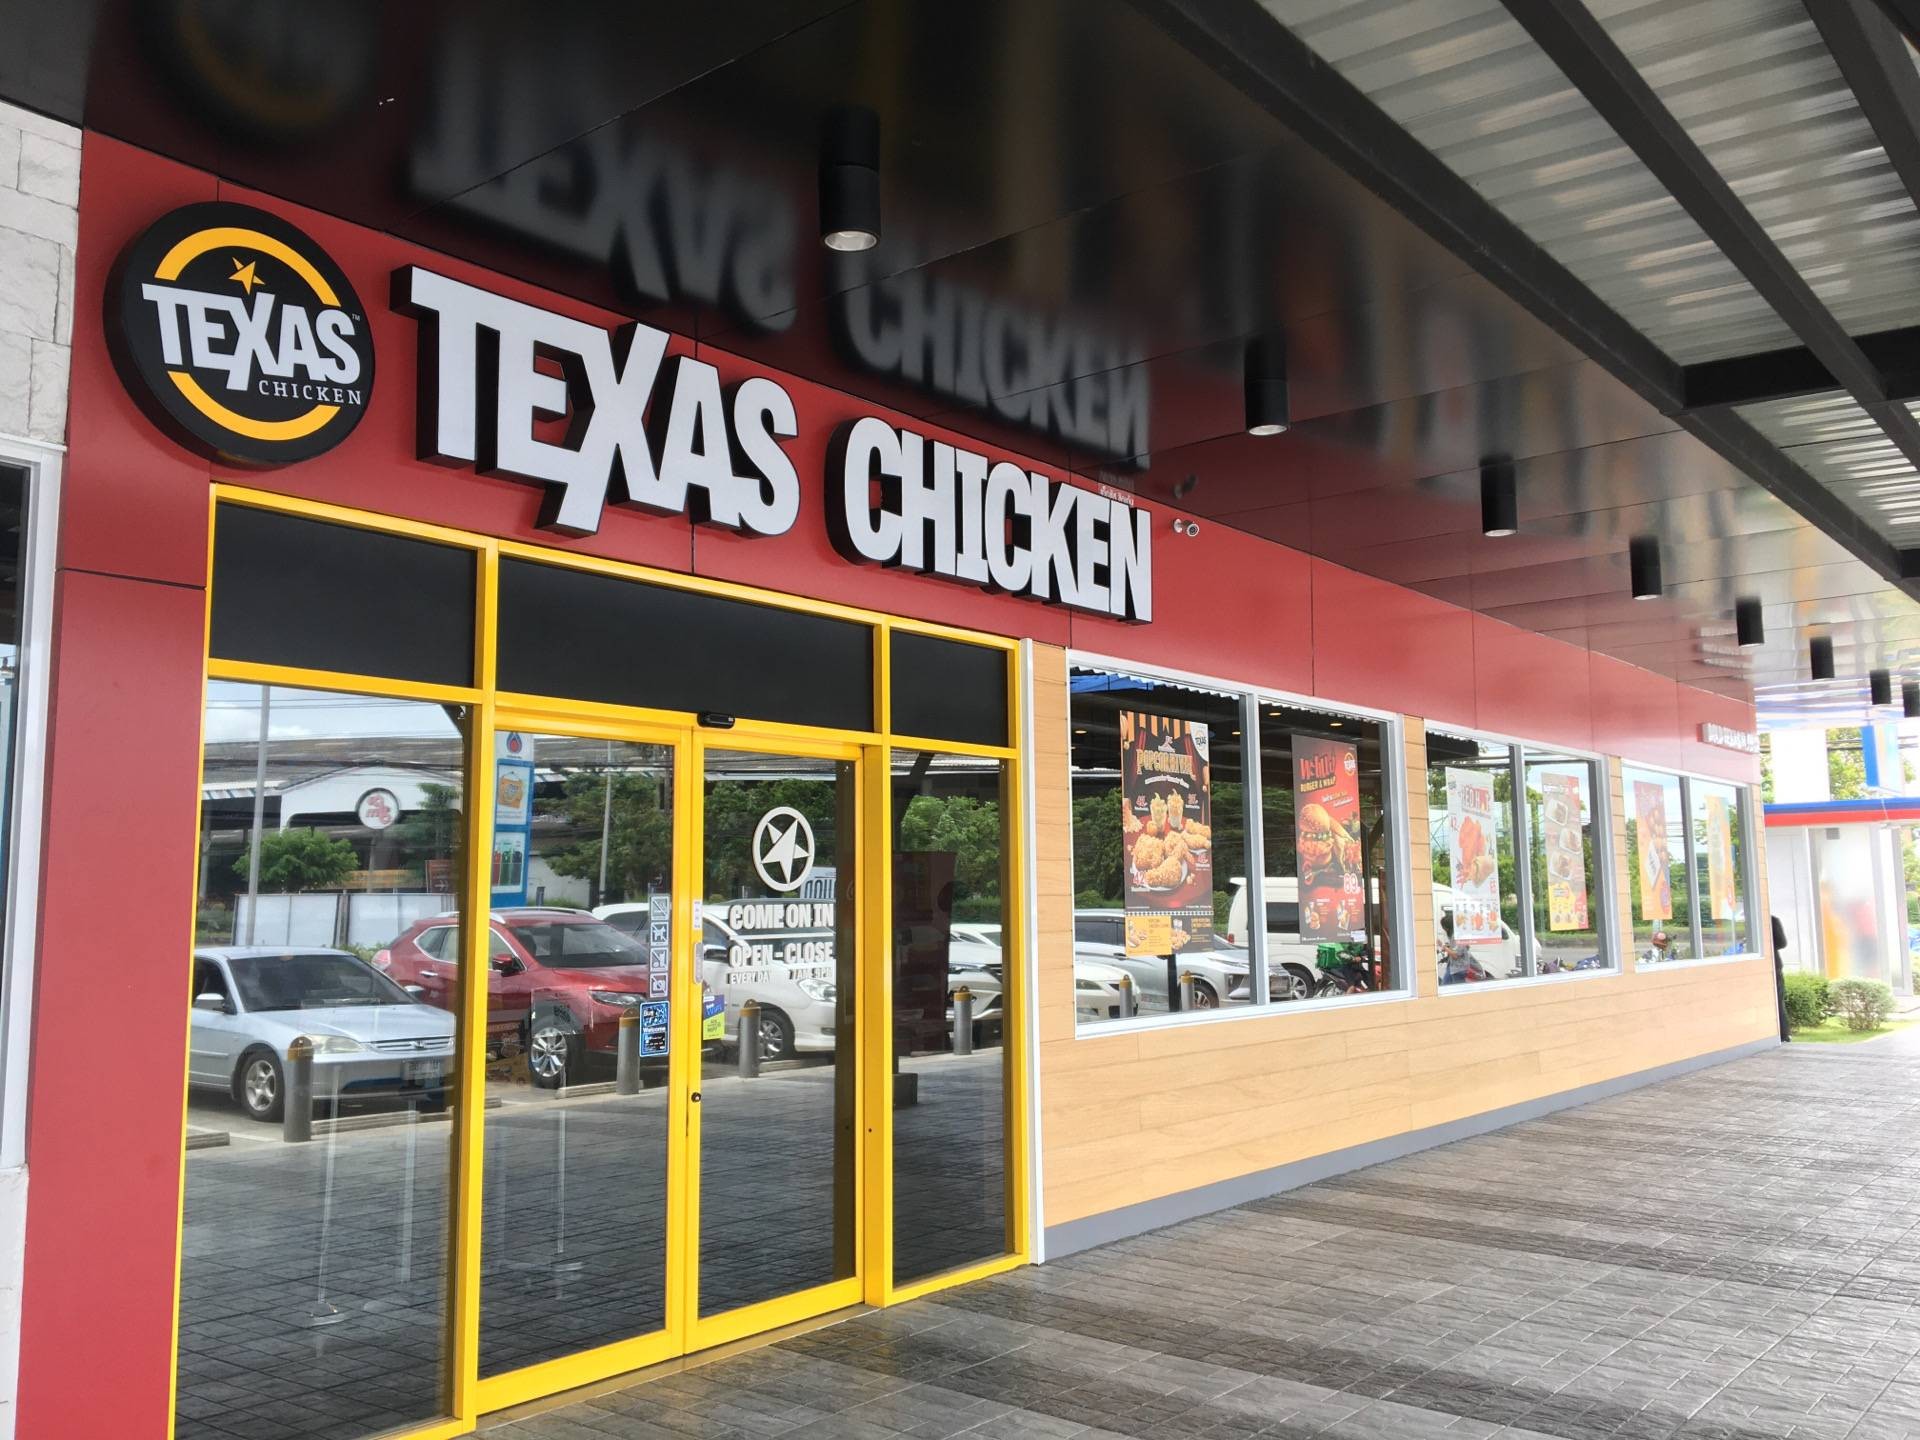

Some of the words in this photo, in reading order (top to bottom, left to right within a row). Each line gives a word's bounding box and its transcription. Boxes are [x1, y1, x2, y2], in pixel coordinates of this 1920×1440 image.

[141, 283, 361, 391] TEXAS
[258, 379, 361, 405] CHICKEN
[411, 265, 799, 535] TEXAS
[844, 416, 1152, 623] CHICKEN
[729, 904, 784, 929] COME
[785, 903, 812, 928] ON
[813, 903, 834, 927] IN
[729, 944, 774, 968] OPEN
[784, 942, 834, 964] CLOSE
